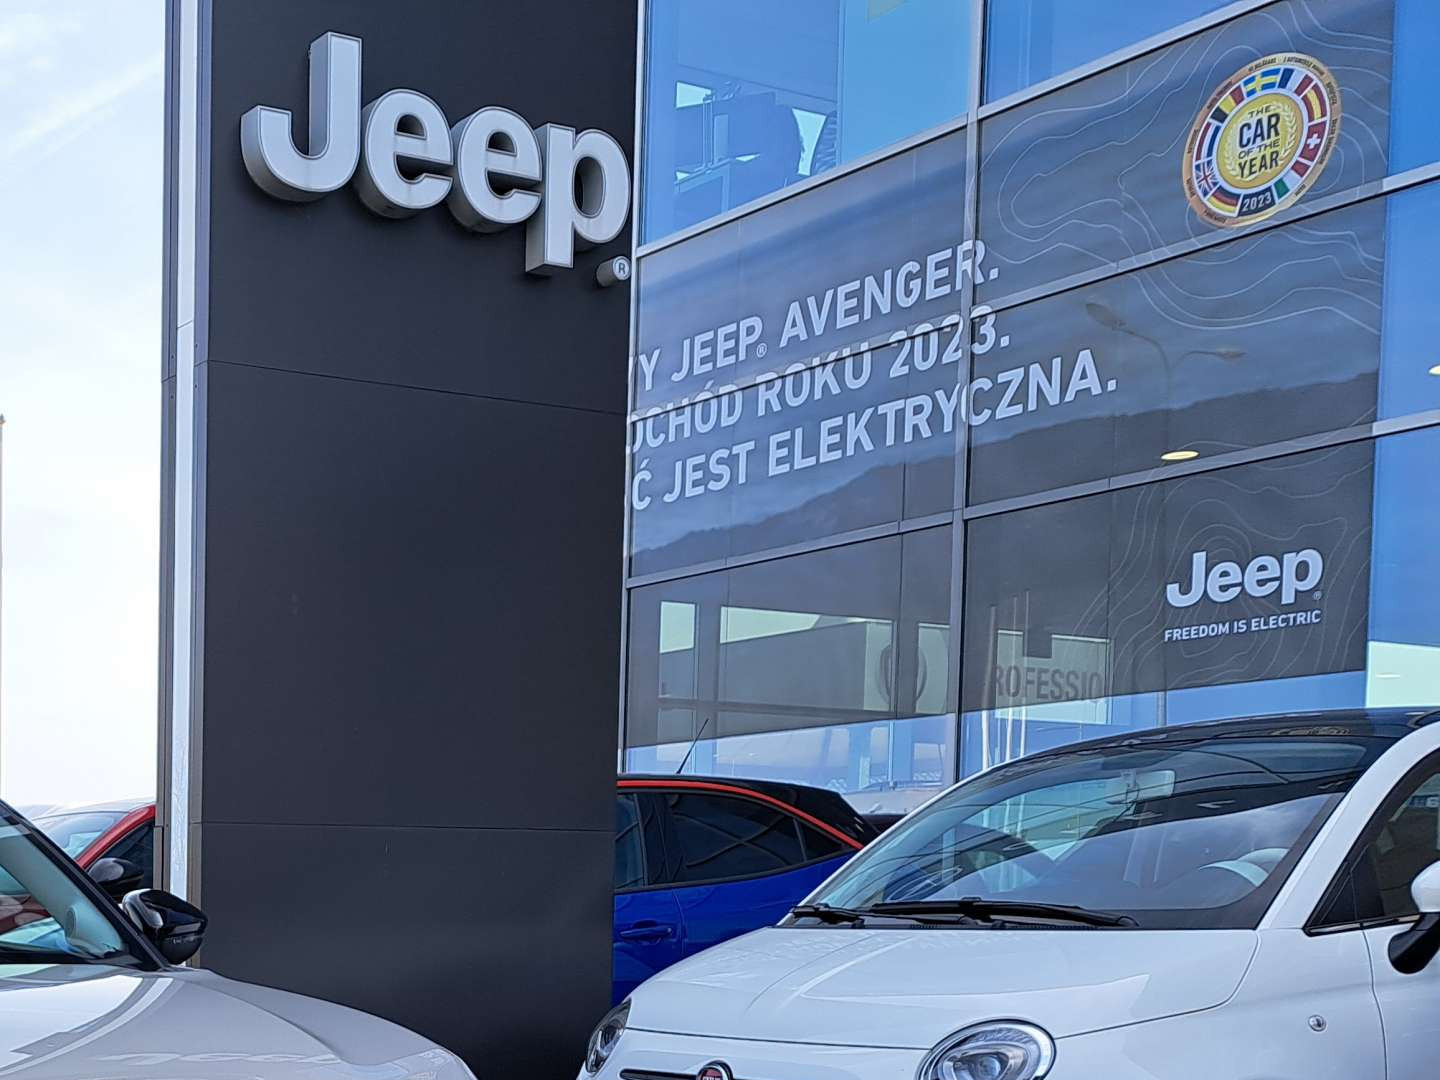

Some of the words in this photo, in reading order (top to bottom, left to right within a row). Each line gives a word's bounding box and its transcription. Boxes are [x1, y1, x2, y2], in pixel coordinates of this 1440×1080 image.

[1248, 105, 1271, 118] THE
[1239, 113, 1280, 148] CAR
[241, 31, 631, 276] Jeep
[1238, 147, 1255, 159] OF
[1256, 138, 1280, 152] THE
[1238, 150, 1279, 178] YEAR
[1242, 192, 1273, 211] 2023
[779, 240, 999, 348] AVENGER.
[756, 342, 872, 417] ROKU
[889, 304, 1010, 378] 2023.
[663, 440, 755, 503] JEST
[768, 349, 1117, 477] ELEKTRYCZNA.
[1166, 548, 1324, 608] Jeep
[1164, 621, 1230, 642] FREEDOM
[1233, 619, 1247, 633] IS
[1251, 610, 1321, 631] ELECTRIC
